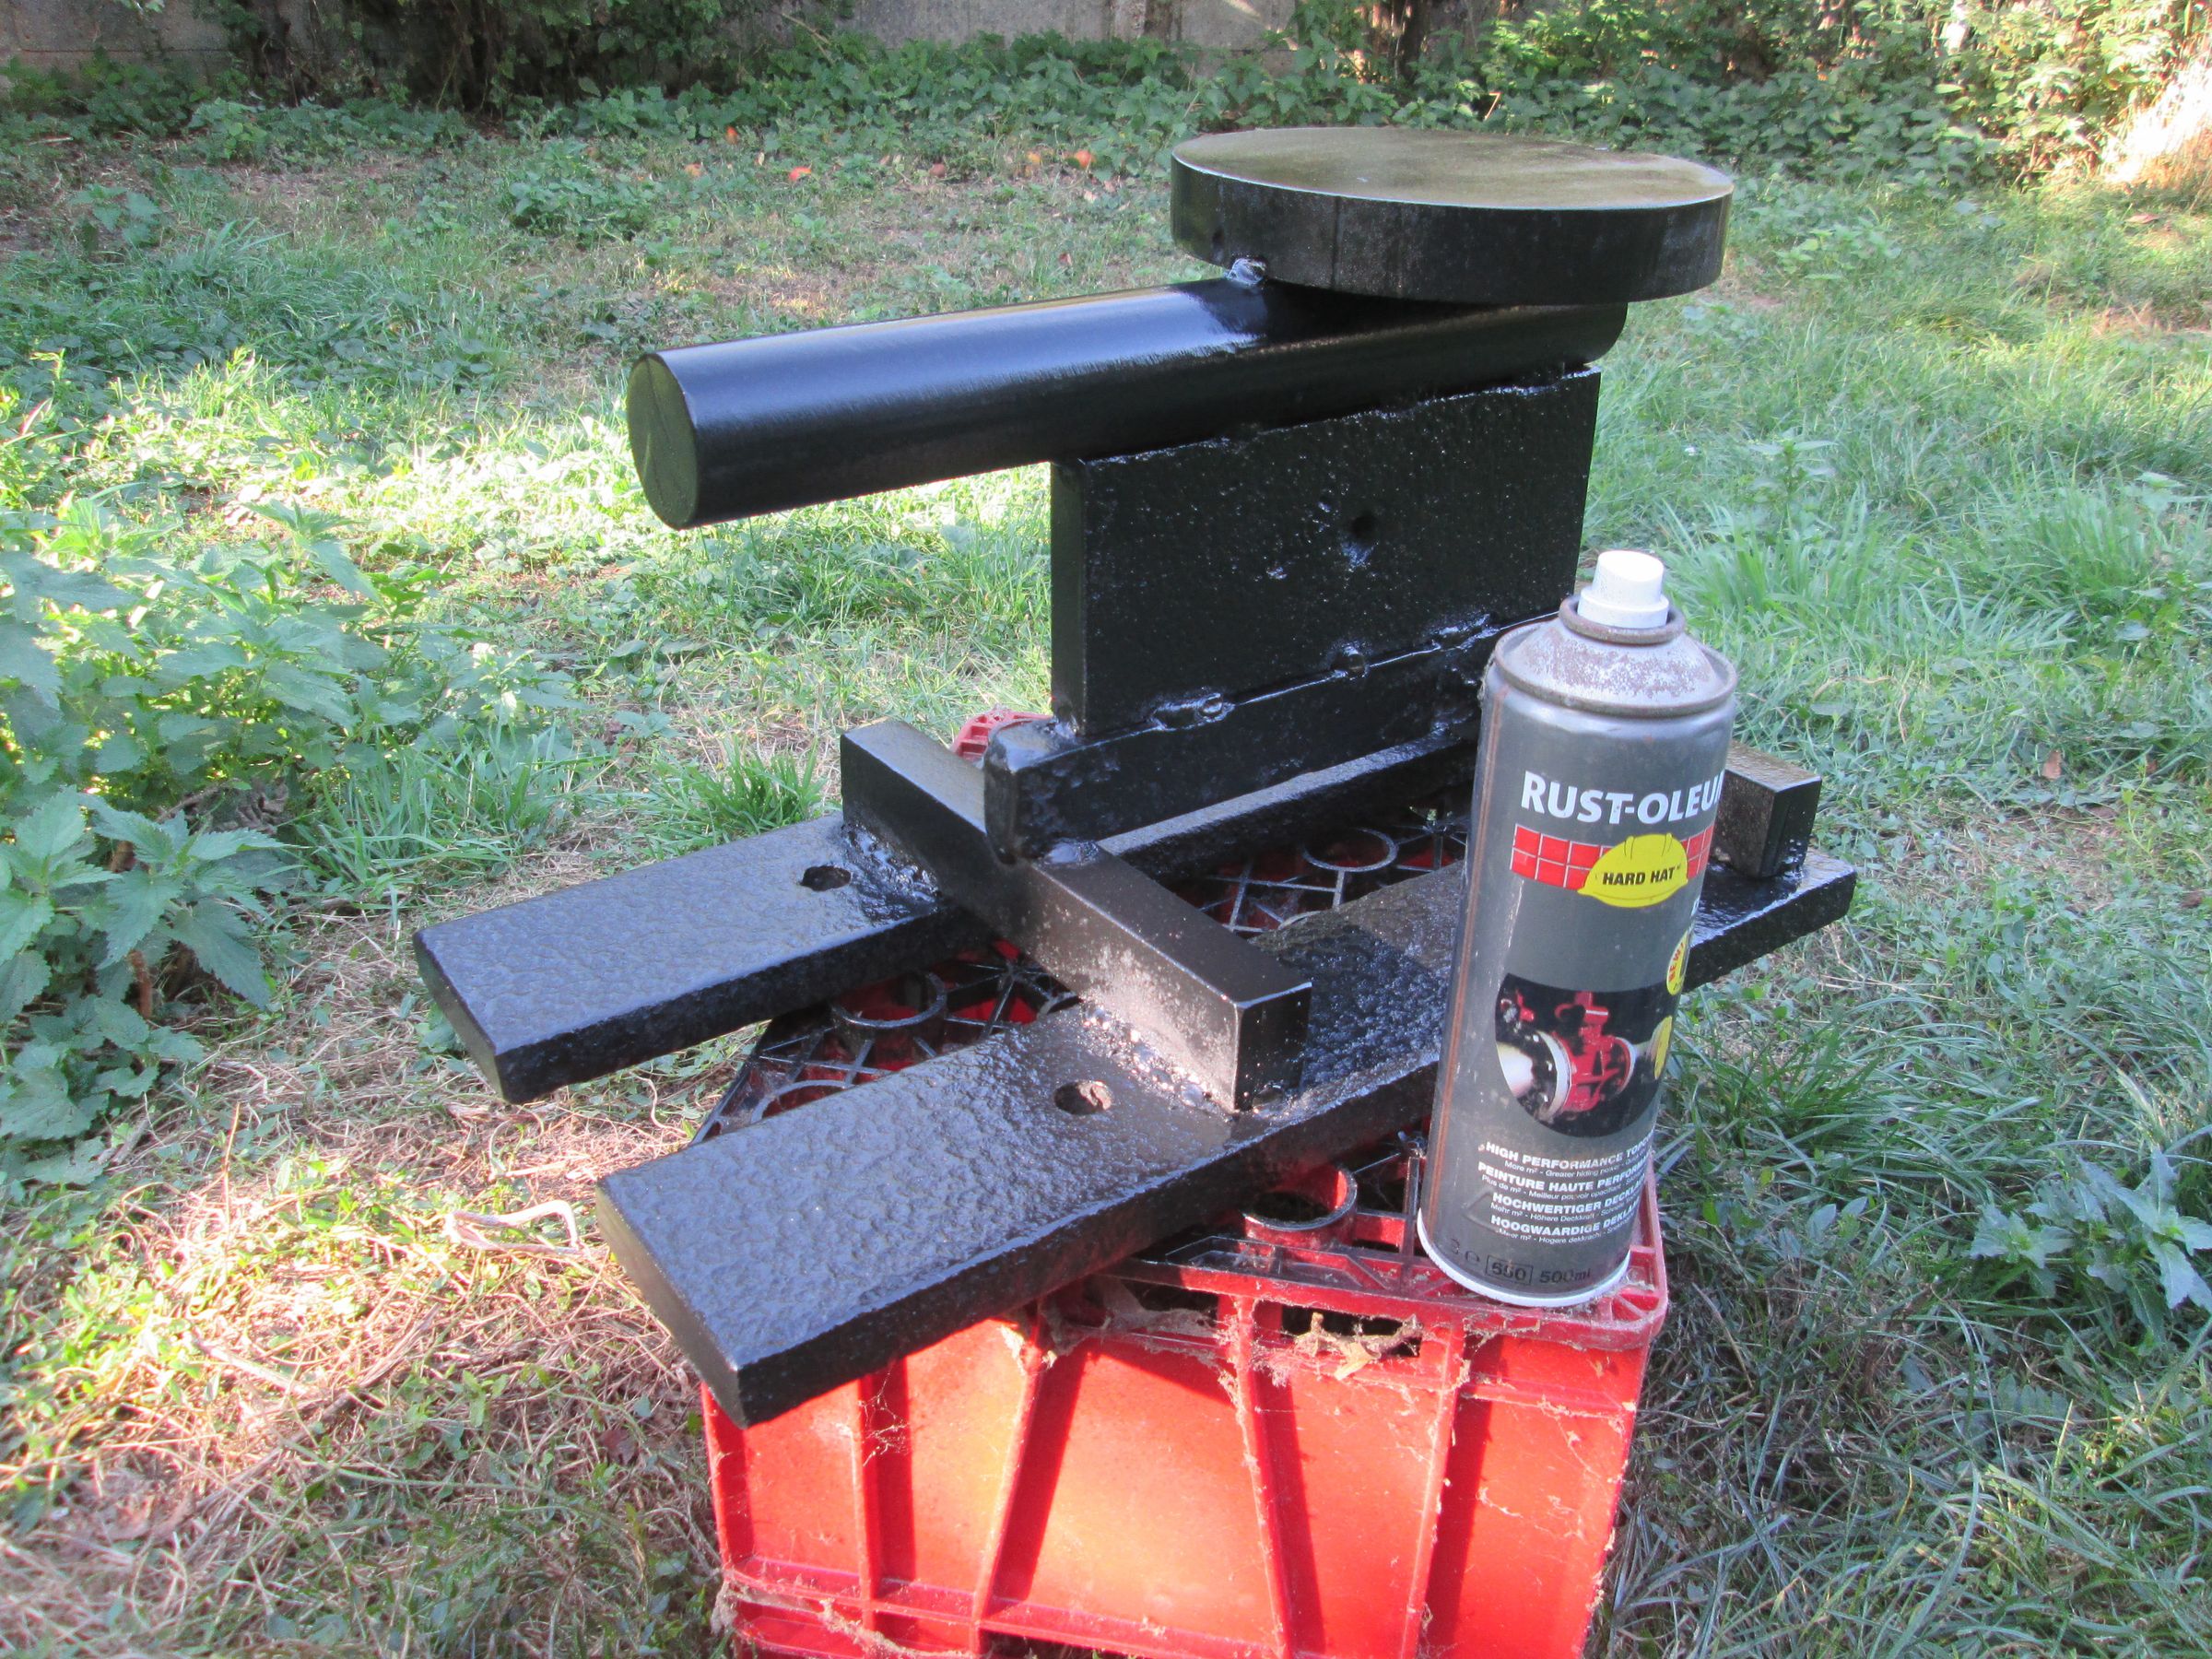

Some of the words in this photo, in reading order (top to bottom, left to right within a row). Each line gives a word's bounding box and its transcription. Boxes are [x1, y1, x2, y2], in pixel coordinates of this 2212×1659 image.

[1602, 871, 1646, 886] HARD
[1650, 865, 1676, 884] HAT
[1486, 1141, 1519, 1162] HIGH
[1522, 1151, 1624, 1171] PERFORMANCE
[1504, 1159, 1525, 1172] More
[1477, 1161, 1546, 1191] PEINTURE
[1548, 1181, 1594, 1193] HAUTE
[1492, 1192, 1602, 1214] HOCHWERTIGER
[1490, 1215, 1601, 1237] HOOGWAARDIGE
